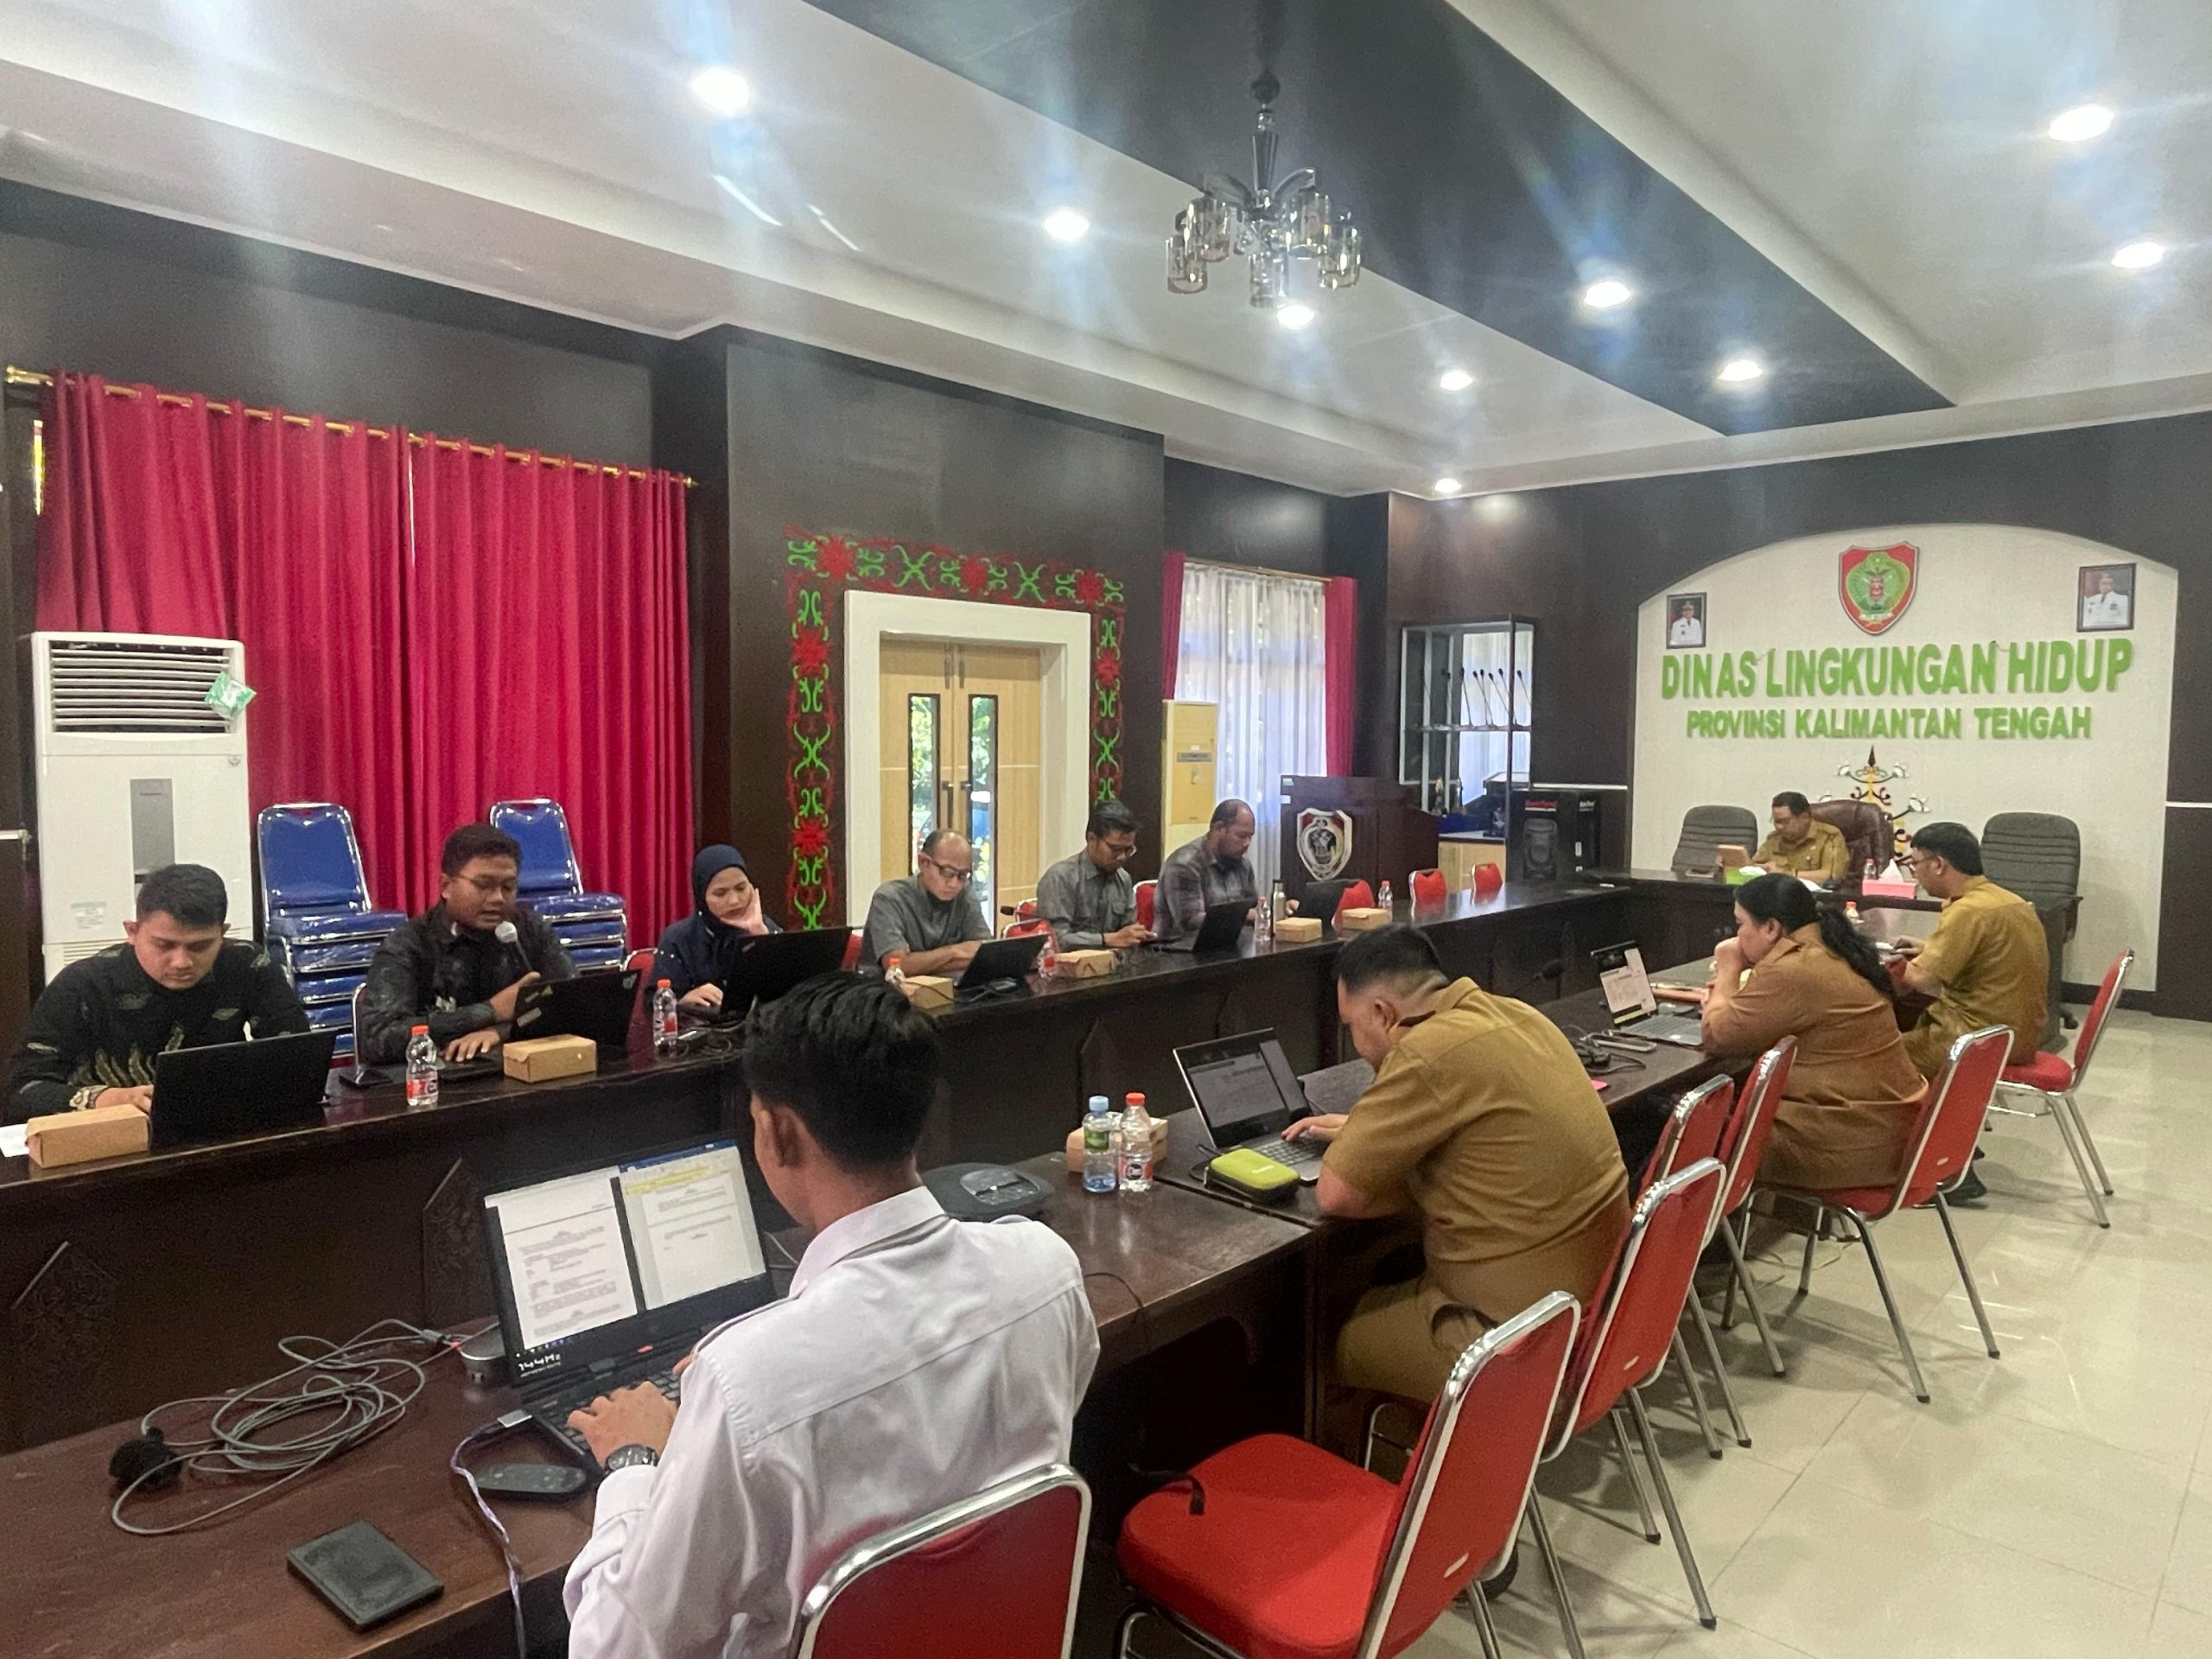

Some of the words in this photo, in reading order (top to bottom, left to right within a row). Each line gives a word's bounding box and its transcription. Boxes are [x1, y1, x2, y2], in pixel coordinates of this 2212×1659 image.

[1662, 651, 1757, 699] DINAS
[1765, 643, 1997, 697] LINGKUNGAN
[2007, 638, 2133, 693] HIDUP
[1687, 709, 1785, 739] PROVINSI
[1795, 709, 1961, 739] KALIMANTAN
[1974, 707, 2092, 739] TENGAH
